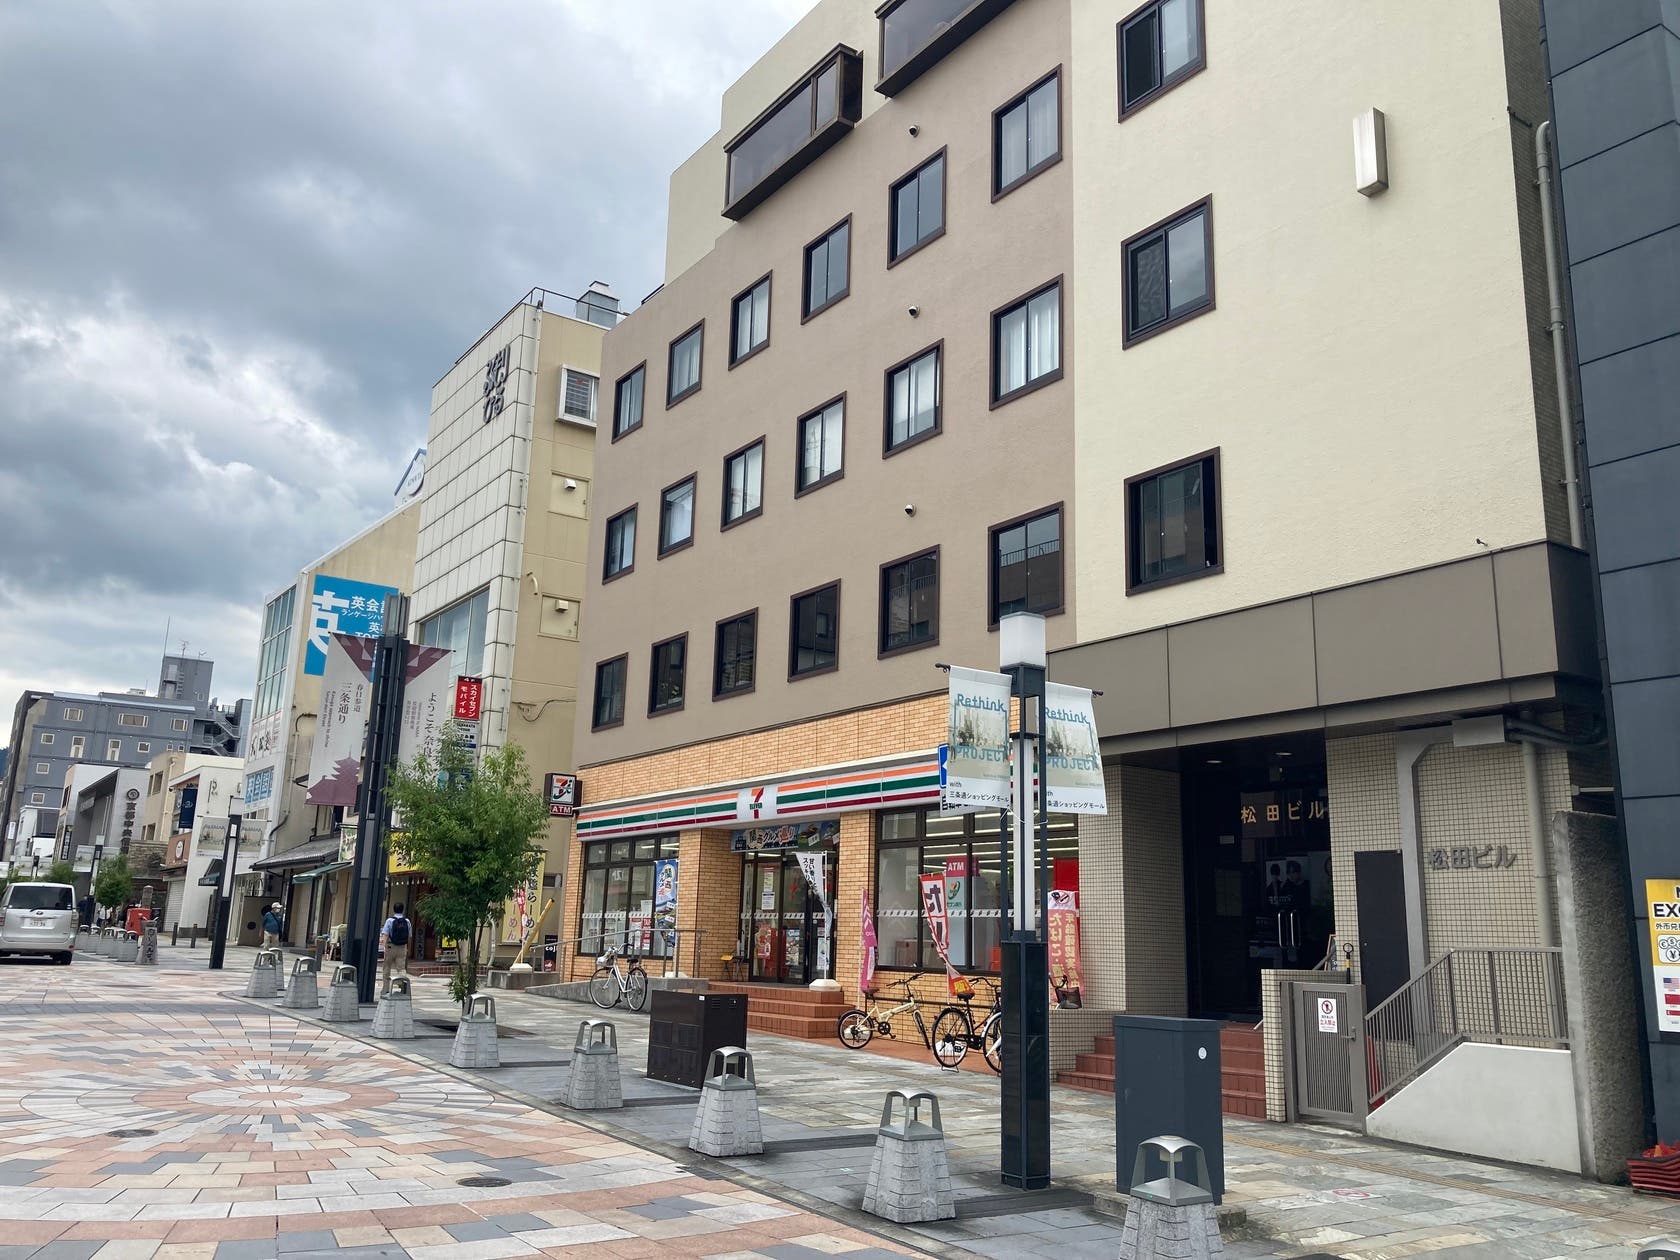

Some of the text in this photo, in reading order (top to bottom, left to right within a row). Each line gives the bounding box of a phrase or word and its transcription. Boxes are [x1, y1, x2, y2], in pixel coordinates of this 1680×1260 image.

[337, 682, 352, 725] 三条通り
[458, 685, 468, 714] モバイル
[468, 684, 478, 718] スカイセブン
[957, 693, 1006, 713] Rethink
[1045, 707, 1091, 725] Rethink
[956, 746, 1008, 763] PROJECT
[1047, 800, 1105, 810] 条通ショッピングモール
[1240, 800, 1325, 824] 松田ビル
[947, 862, 965, 872] ATM
[1427, 844, 1518, 870] 松田ビル
